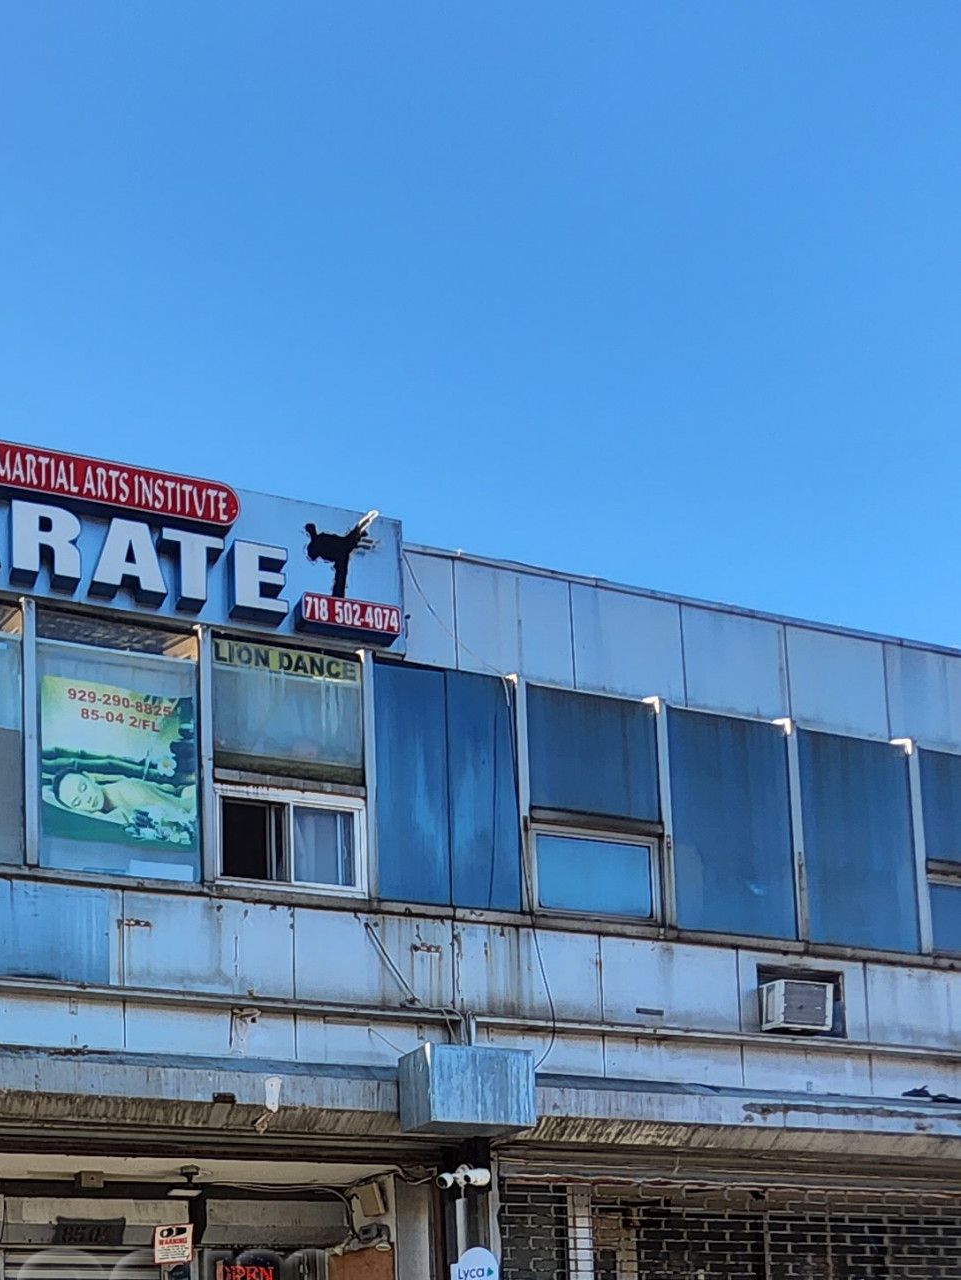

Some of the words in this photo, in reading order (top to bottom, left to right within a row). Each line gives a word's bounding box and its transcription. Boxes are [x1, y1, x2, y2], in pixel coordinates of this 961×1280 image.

[82, 466, 129, 503] ARTS
[304, 595, 329, 621] 718
[334, 601, 400, 632] 502-4074
[214, 638, 270, 667] LION
[278, 651, 357, 681] DANCE
[67, 687, 175, 718] 929-290-8825
[80, 707, 125, 724] 85-04
